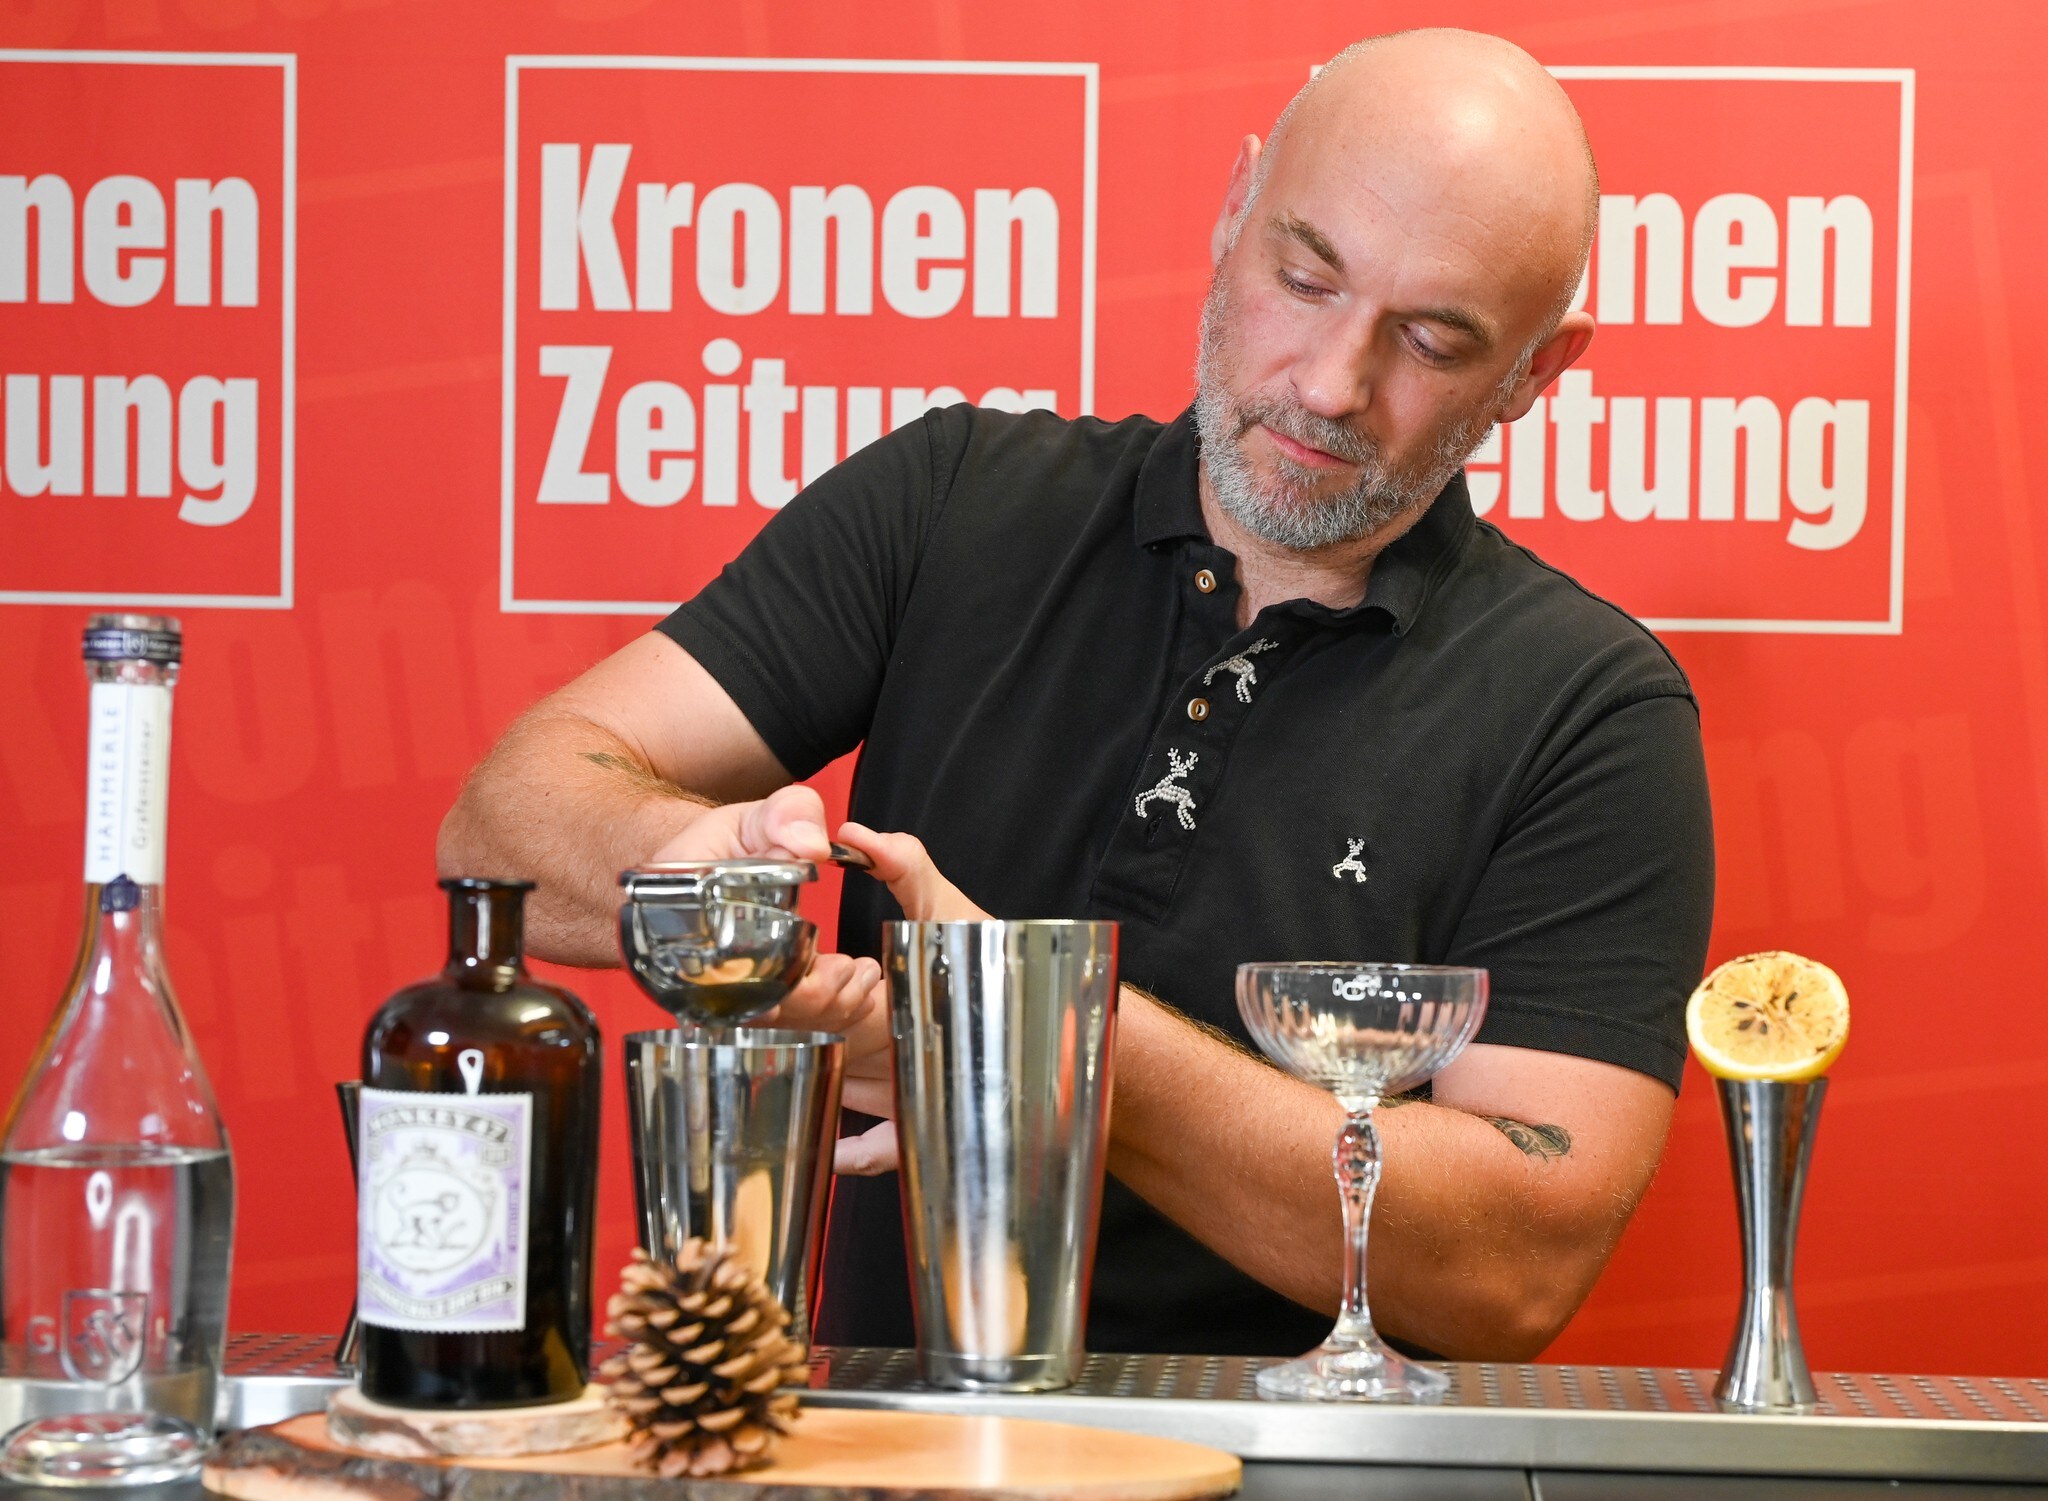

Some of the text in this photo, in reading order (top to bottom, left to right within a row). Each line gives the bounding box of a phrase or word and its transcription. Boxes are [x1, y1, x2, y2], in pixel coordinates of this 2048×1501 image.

[0, 173, 259, 308] nen
[539, 142, 1060, 319] Kronen
[1566, 193, 1874, 328] nen
[0, 374, 259, 528] ung
[536, 338, 1058, 511] Zeitu
